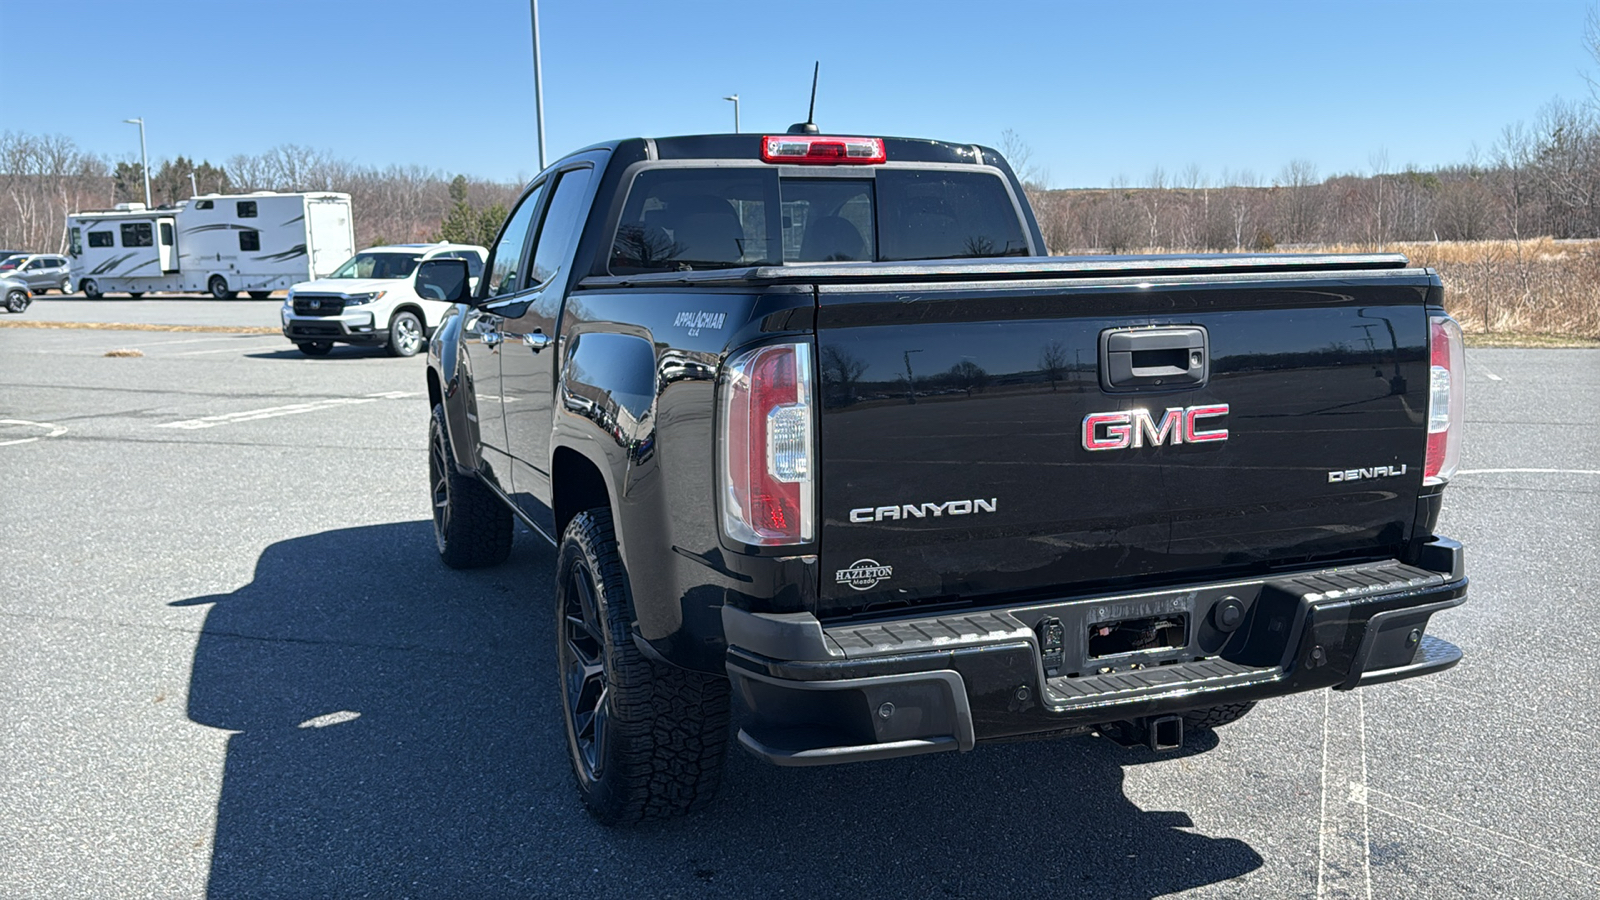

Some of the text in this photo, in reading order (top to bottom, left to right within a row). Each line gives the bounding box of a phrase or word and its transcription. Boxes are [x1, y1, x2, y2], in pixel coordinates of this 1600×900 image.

[673, 310, 726, 329] APPALACHIAN
[1082, 404, 1229, 450] GMC
[1328, 464, 1407, 483] DENALI
[850, 498, 997, 523] CANYON
[835, 567, 893, 580] HAZLETON
